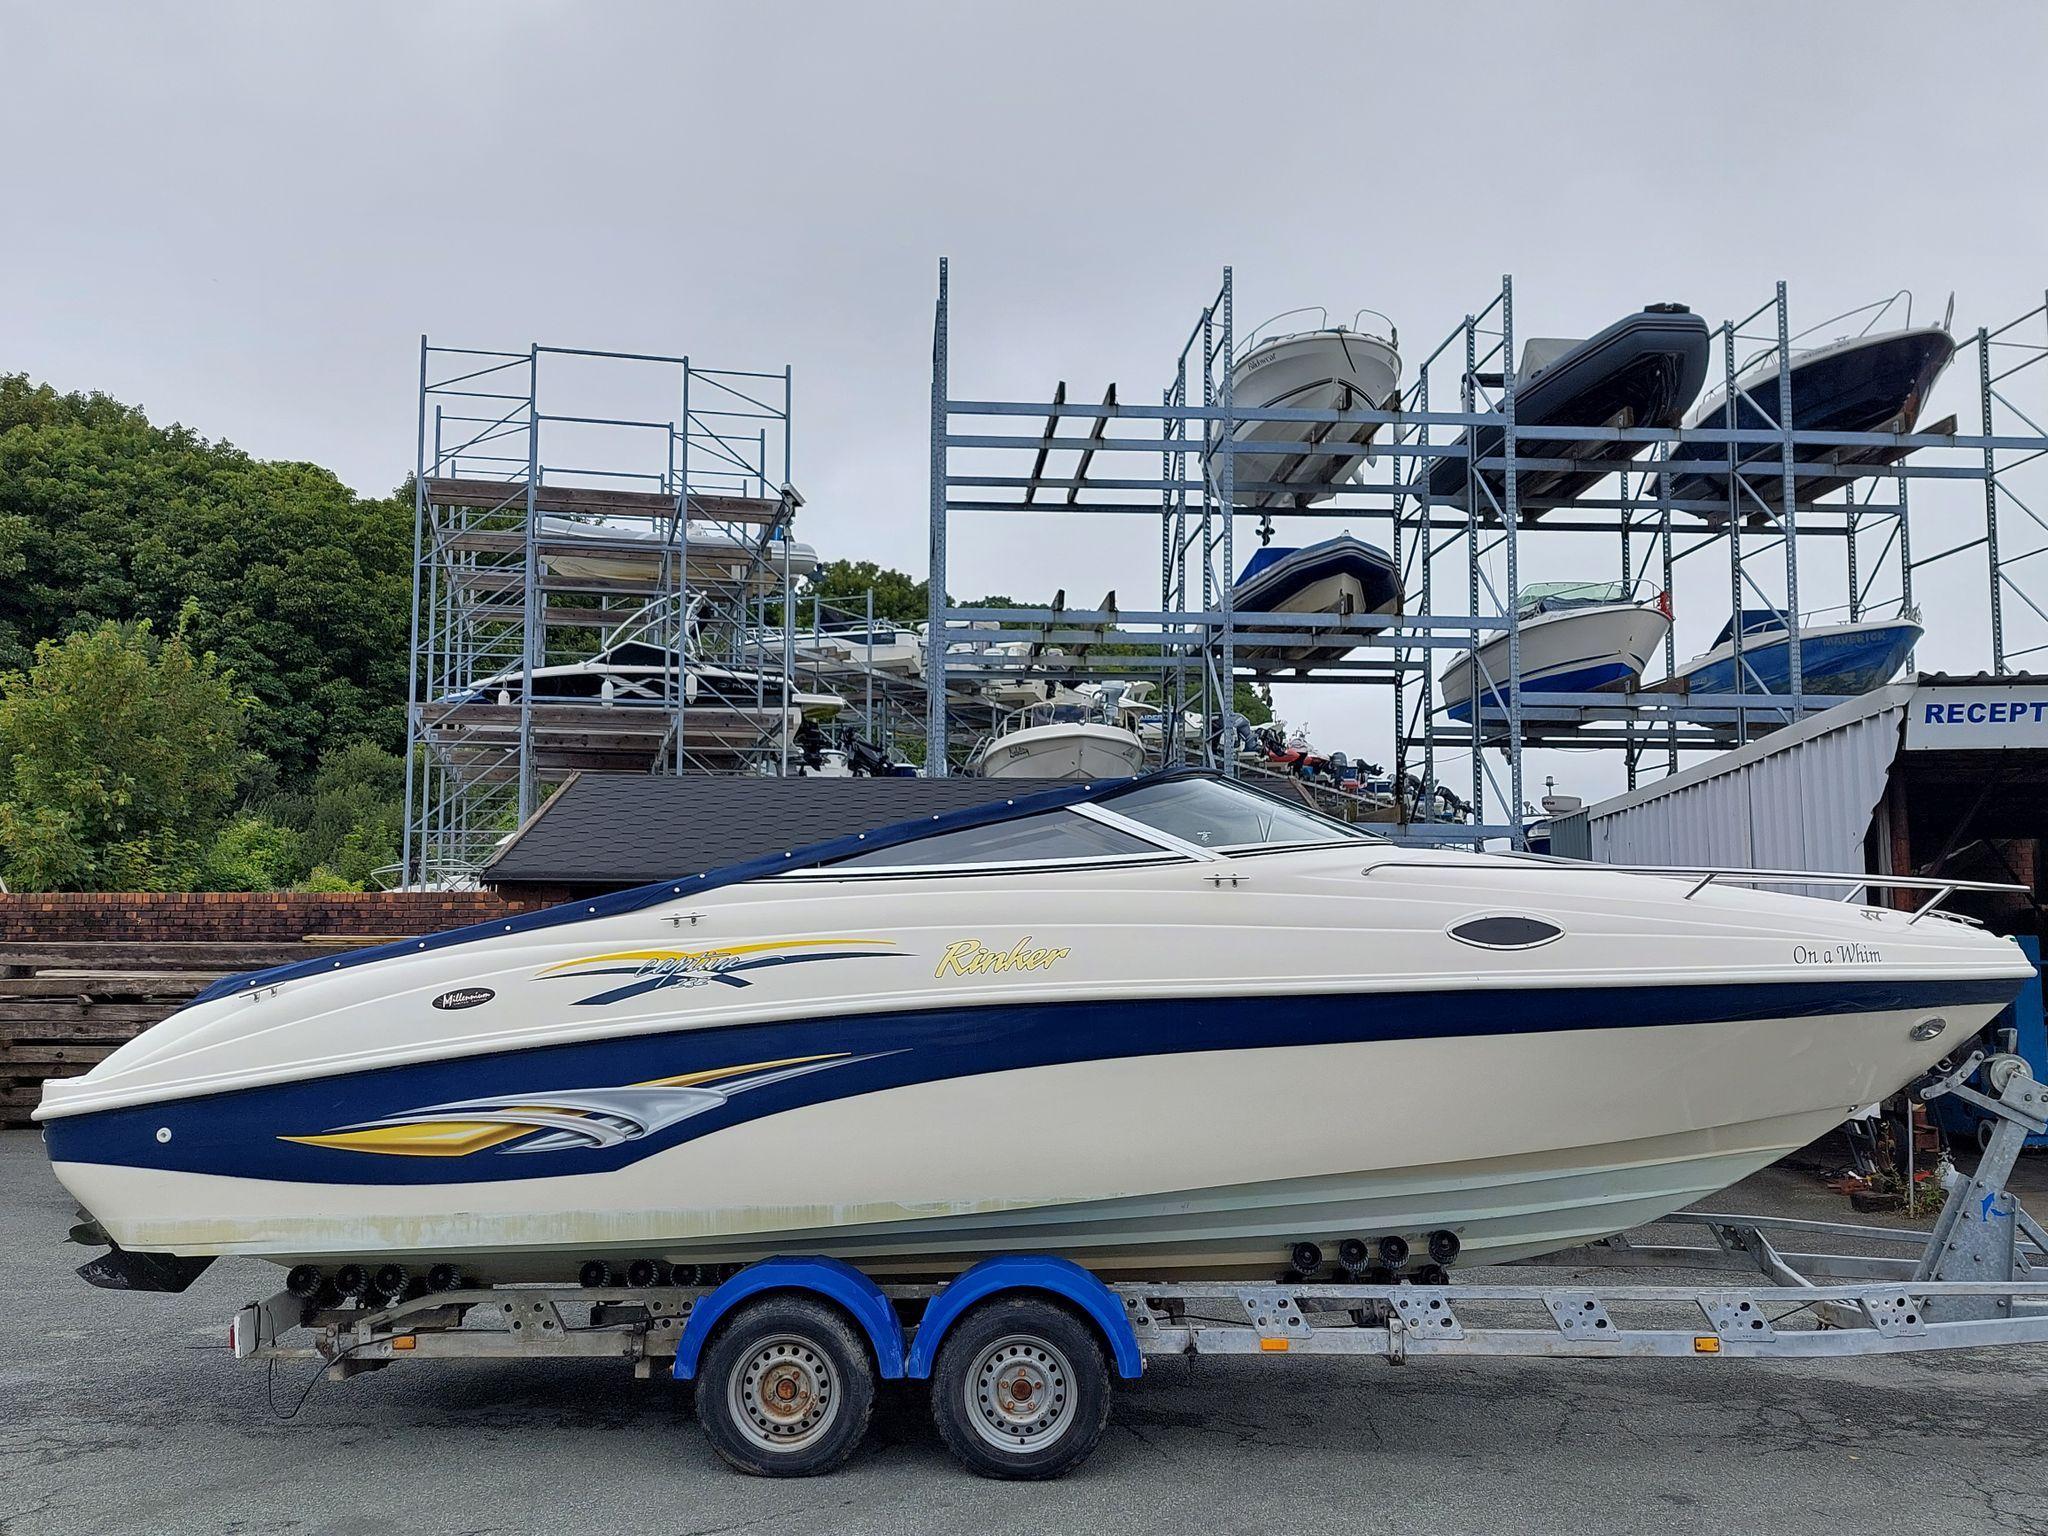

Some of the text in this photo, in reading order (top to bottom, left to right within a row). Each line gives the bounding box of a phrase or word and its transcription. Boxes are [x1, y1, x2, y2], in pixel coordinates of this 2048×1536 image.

[1924, 702, 2048, 724] RECEPT
[934, 935, 1072, 979] Rinker
[1793, 942, 1883, 965] On a Whim
[442, 991, 491, 1008] Millennium
